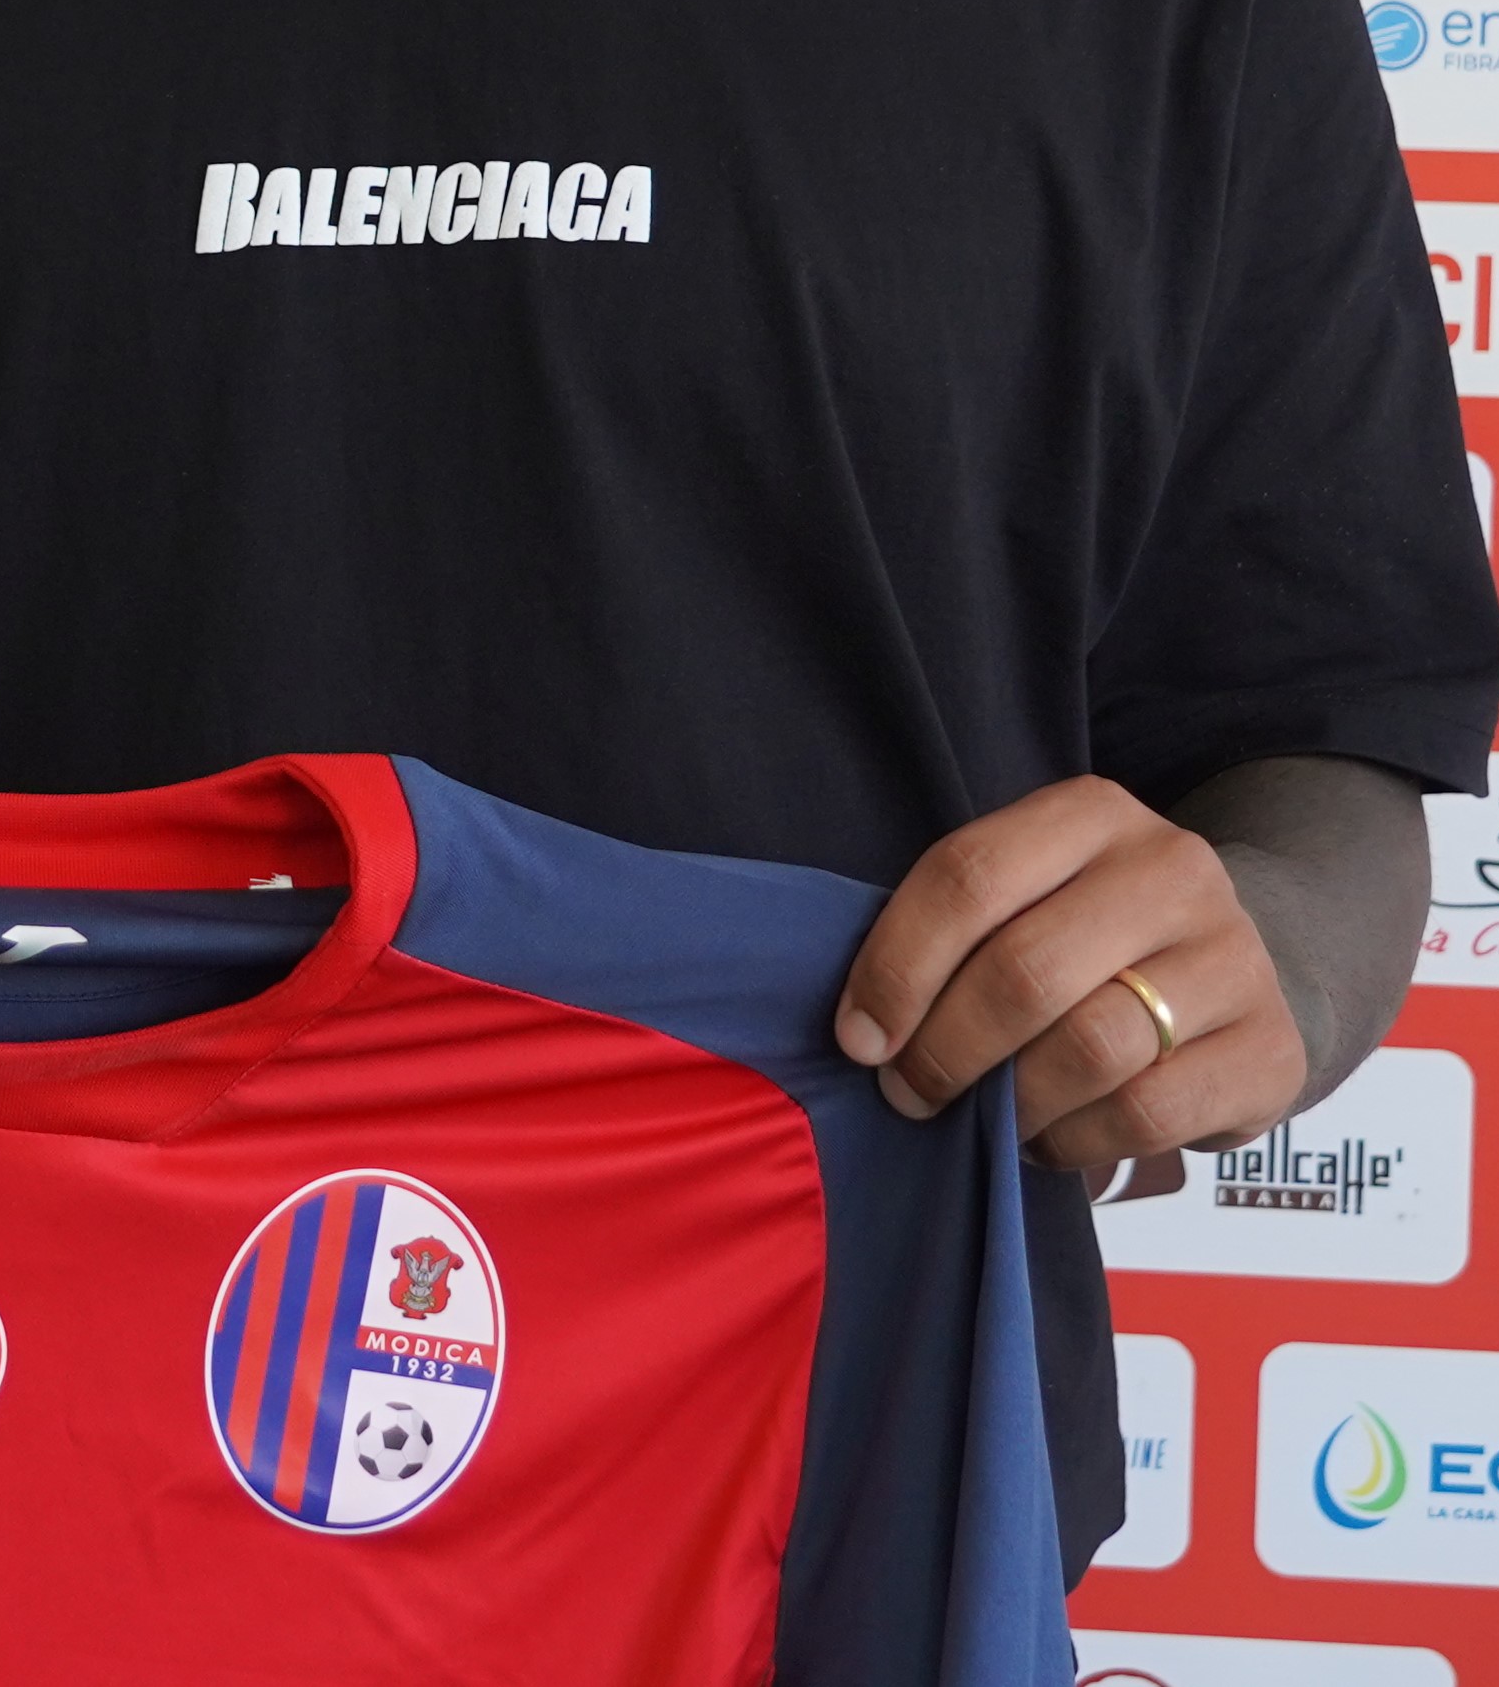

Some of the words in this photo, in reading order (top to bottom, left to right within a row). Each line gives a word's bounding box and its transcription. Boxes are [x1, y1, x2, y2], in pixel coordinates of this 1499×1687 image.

[195, 161, 651, 253] BALENCIAGA
[365, 1331, 484, 1366] MODICA
[391, 1355, 454, 1381] 1932
[1452, 1507, 1498, 1522] CASA
